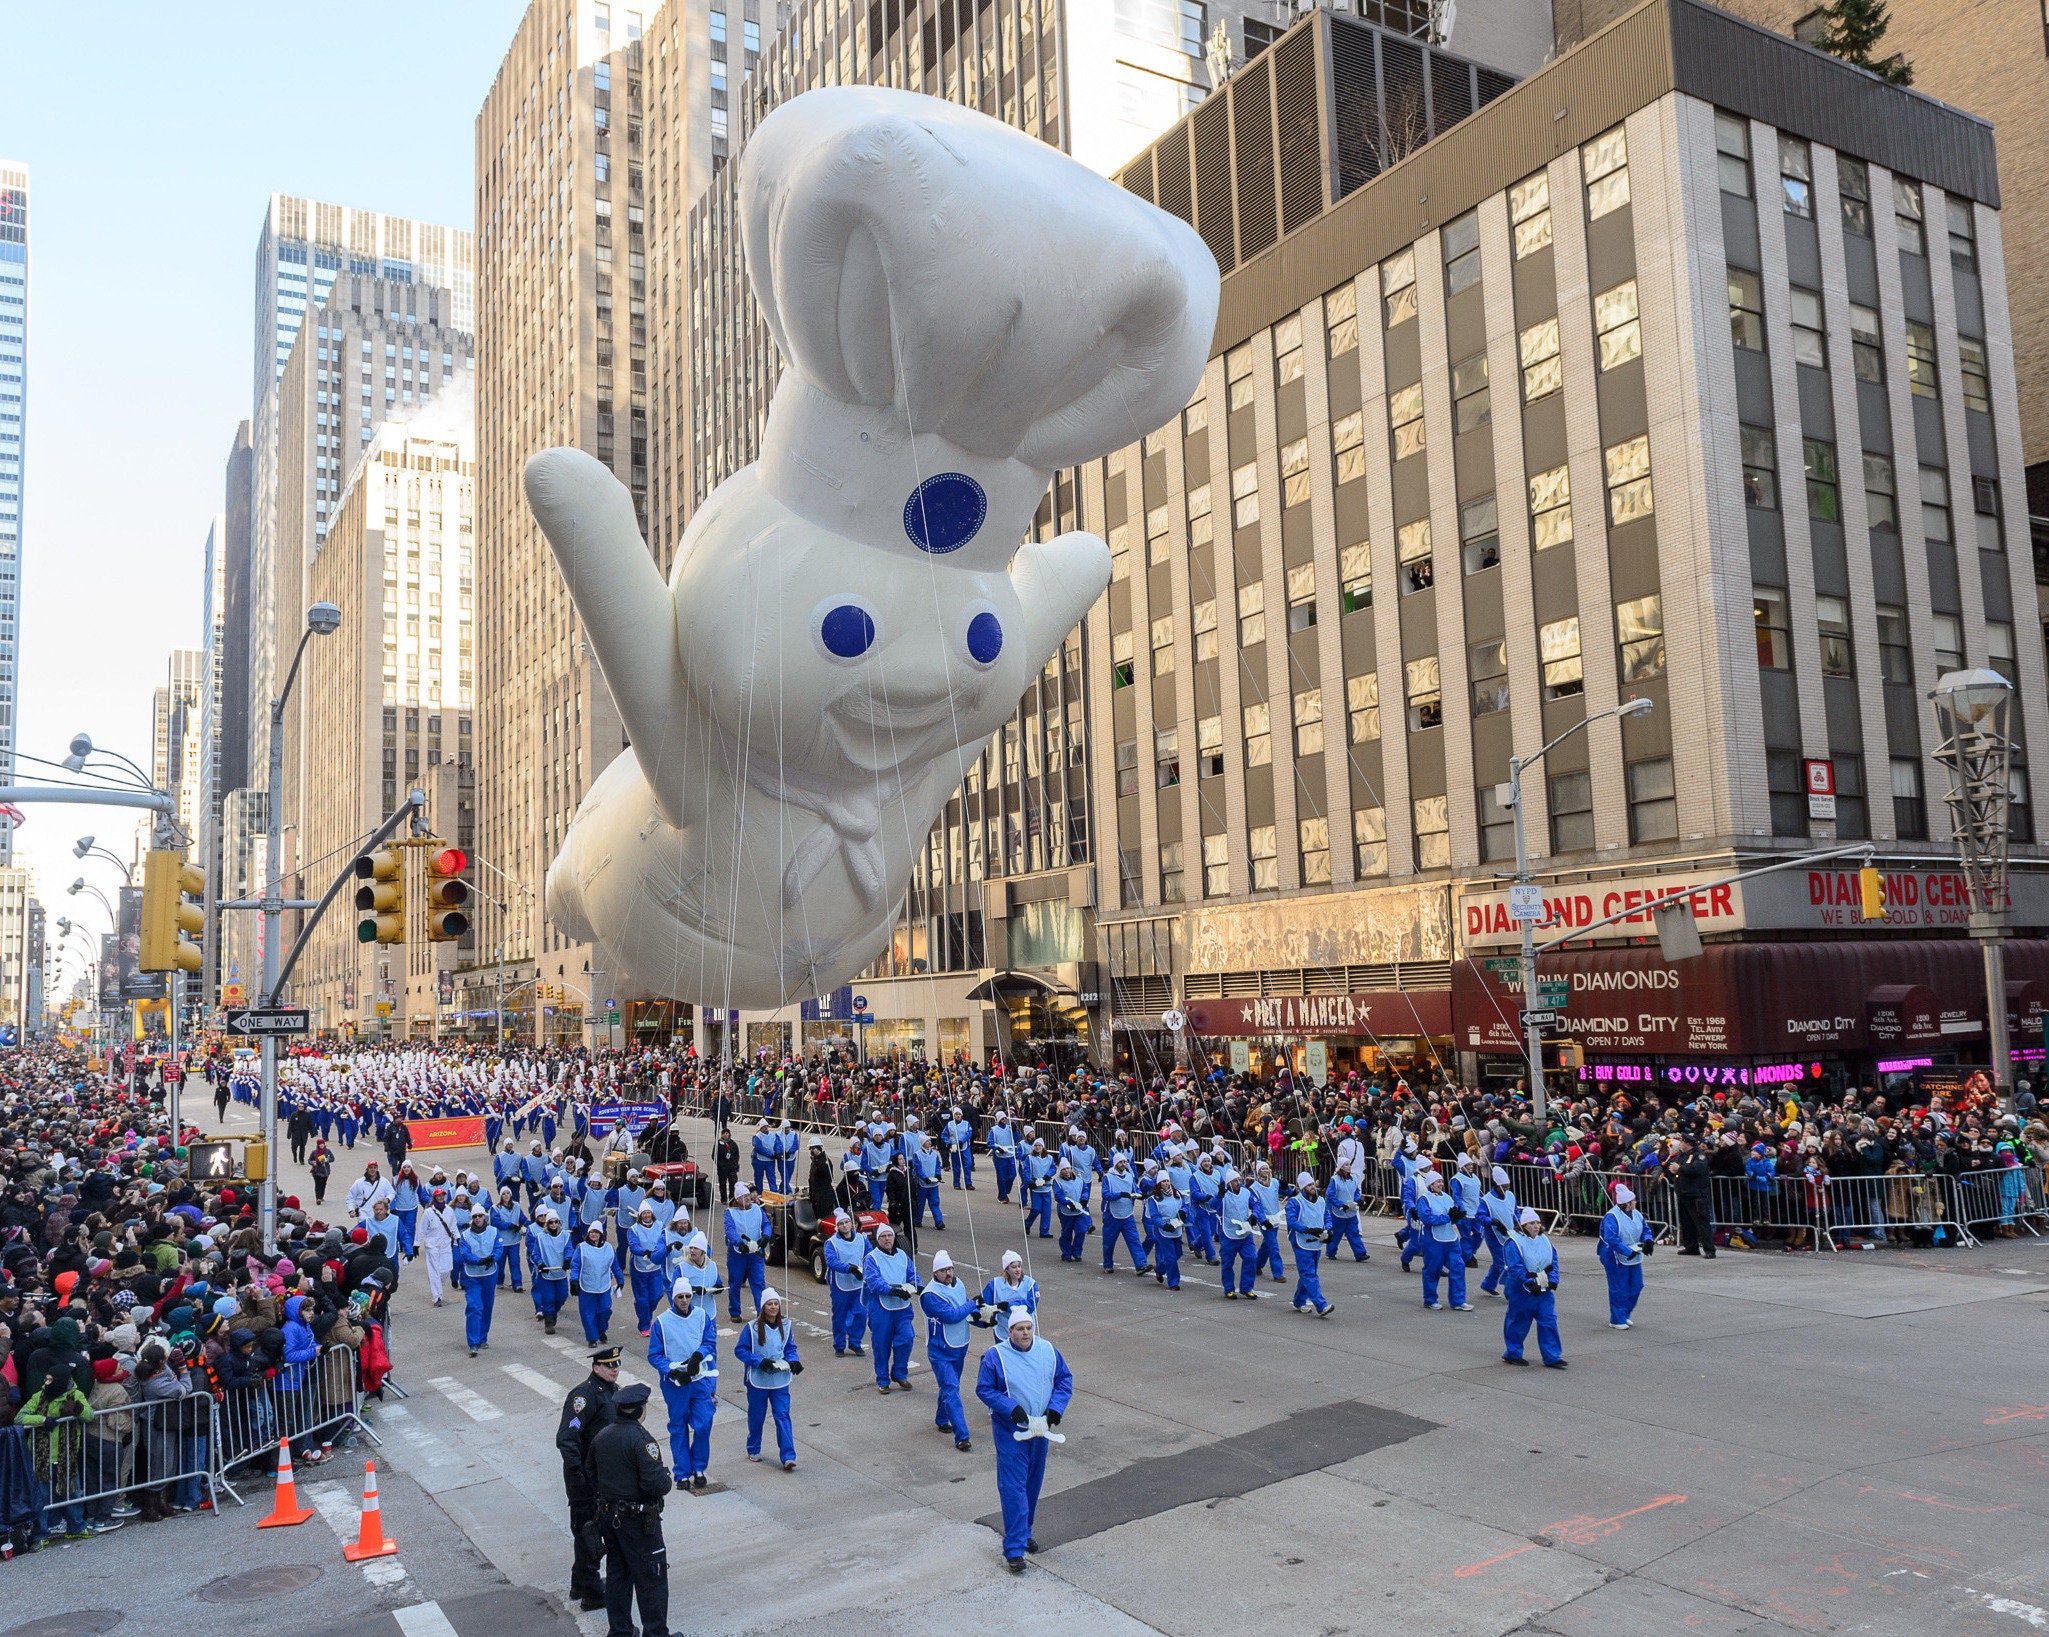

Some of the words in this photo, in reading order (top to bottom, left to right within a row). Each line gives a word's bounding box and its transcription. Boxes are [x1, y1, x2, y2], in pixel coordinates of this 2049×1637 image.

[1515, 887, 1538, 895] NYPD
[1511, 903, 1542, 911] SECURITY
[1467, 896, 1593, 936] DIAOND
[1821, 909, 1844, 924] WE
[1882, 909, 1918, 924] GOLD
[1925, 910, 1934, 924] &
[1503, 972, 1509, 981] 6
[1573, 969, 1680, 992] DIAMONDS
[1550, 996, 1560, 1006] 47
[1254, 998, 1283, 1027] PRET
[1286, 998, 1295, 1027] A
[1298, 995, 1356, 1027] MANGER
[1940, 1010, 1967, 1018] JEWELRY
[1540, 1013, 1553, 1021] WAY
[1706, 1016, 1726, 1025] 1968
[239, 1017, 263, 1028] ONE
[274, 1016, 299, 1027] WAY
[1555, 1015, 1629, 1033] DIAMOND
[1638, 1013, 1679, 1033] CITY
[1787, 1018, 1831, 1034] DIAMOND
[1834, 1016, 1856, 1031] CITY
[1690, 1025, 1705, 1033] TEL
[1706, 1025, 1723, 1033] AVIV
[1870, 1024, 1902, 1032] DIAMOND
[1689, 1033, 1727, 1041] ANTWERP
[1806, 1033, 1821, 1042] OPEN
[1826, 1032, 1839, 1041] DAYS
[1878, 1032, 1896, 1040] CITY
[1586, 1036, 1612, 1046] OPEN
[1613, 1036, 1619, 1046] 7
[1621, 1036, 1645, 1046] DAYS
[1688, 1041, 1706, 1050] NEW
[1707, 1041, 1728, 1050] YORK
[1595, 1065, 1613, 1080] BUY
[1616, 1065, 1641, 1080] GOLD
[1644, 1066, 1653, 1081] &
[428, 1130, 457, 1138] ARIZONA
